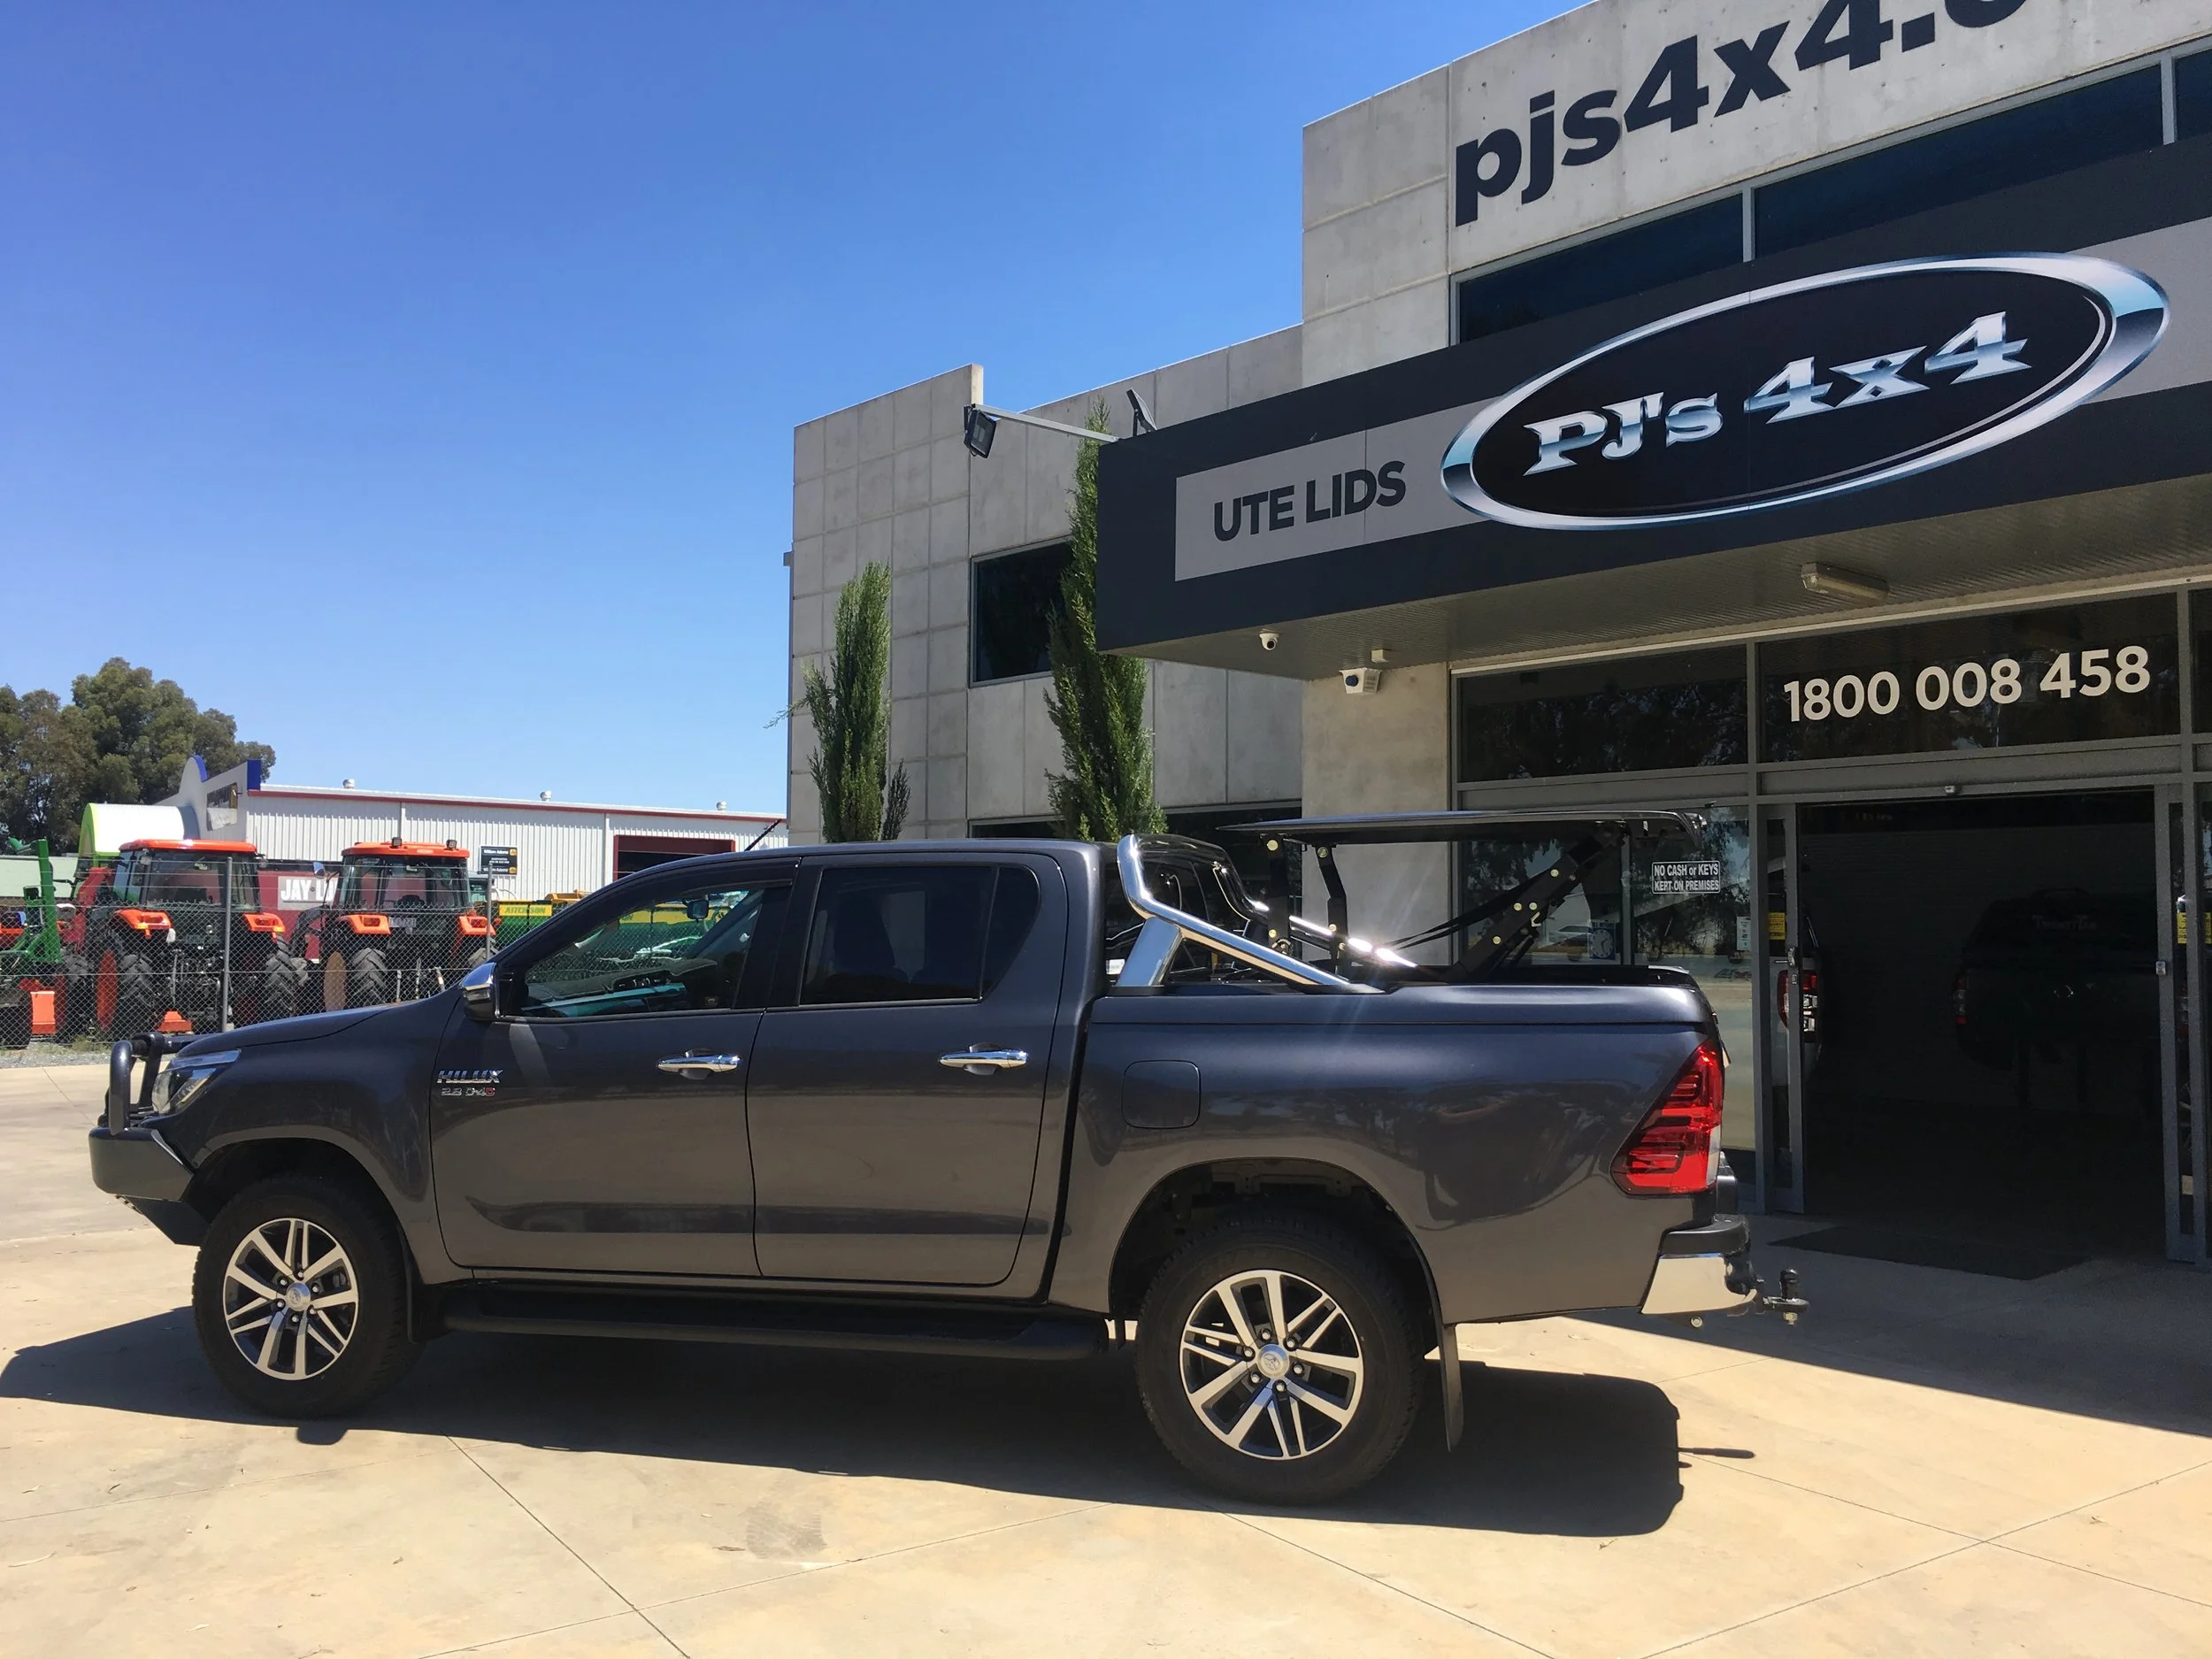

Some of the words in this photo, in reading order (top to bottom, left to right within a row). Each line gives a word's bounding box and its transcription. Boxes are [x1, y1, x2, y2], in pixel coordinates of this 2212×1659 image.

[1743, 311, 2032, 425] 4x4
[1213, 484, 1295, 541] UTE
[1305, 460, 1406, 524] LIDS
[1783, 671, 1901, 722] 1800
[1916, 658, 2022, 711] 008
[2039, 645, 2151, 699] 458
[1654, 864, 1665, 876] NO
[1667, 864, 1687, 876] CASH
[1688, 866, 1697, 876] or
[1698, 864, 1718, 875] KEYS
[280, 879, 311, 901] JAY
[1654, 880, 1672, 891] KEPT
[1673, 880, 1684, 891] ON
[1685, 879, 1719, 891] PREMISES
[436, 1069, 503, 1084] HILUX
